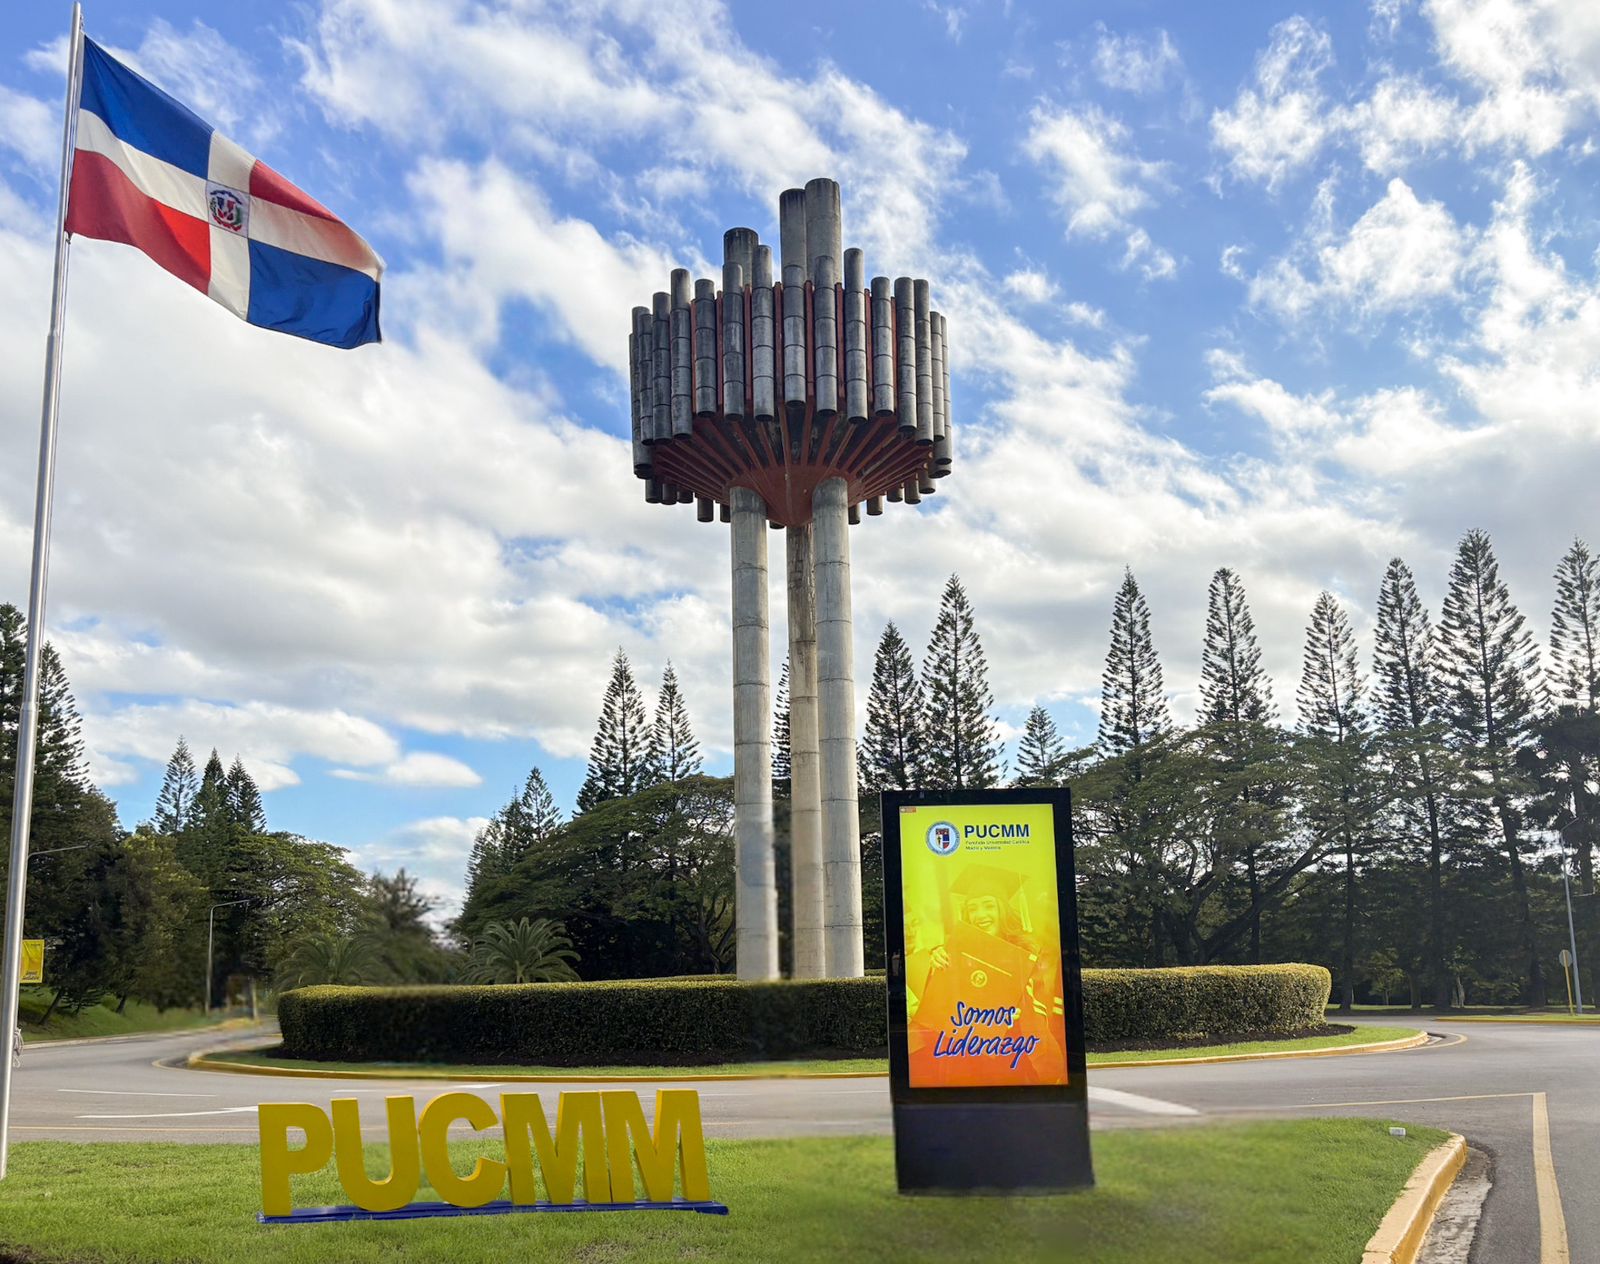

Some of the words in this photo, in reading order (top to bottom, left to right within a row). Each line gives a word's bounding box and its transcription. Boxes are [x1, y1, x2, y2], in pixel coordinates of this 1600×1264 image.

[964, 824, 1030, 838] PUCMM
[950, 1000, 1016, 1028] Somos
[933, 1026, 1040, 1070] Liderazgo
[257, 1088, 711, 1217] PUCMM
